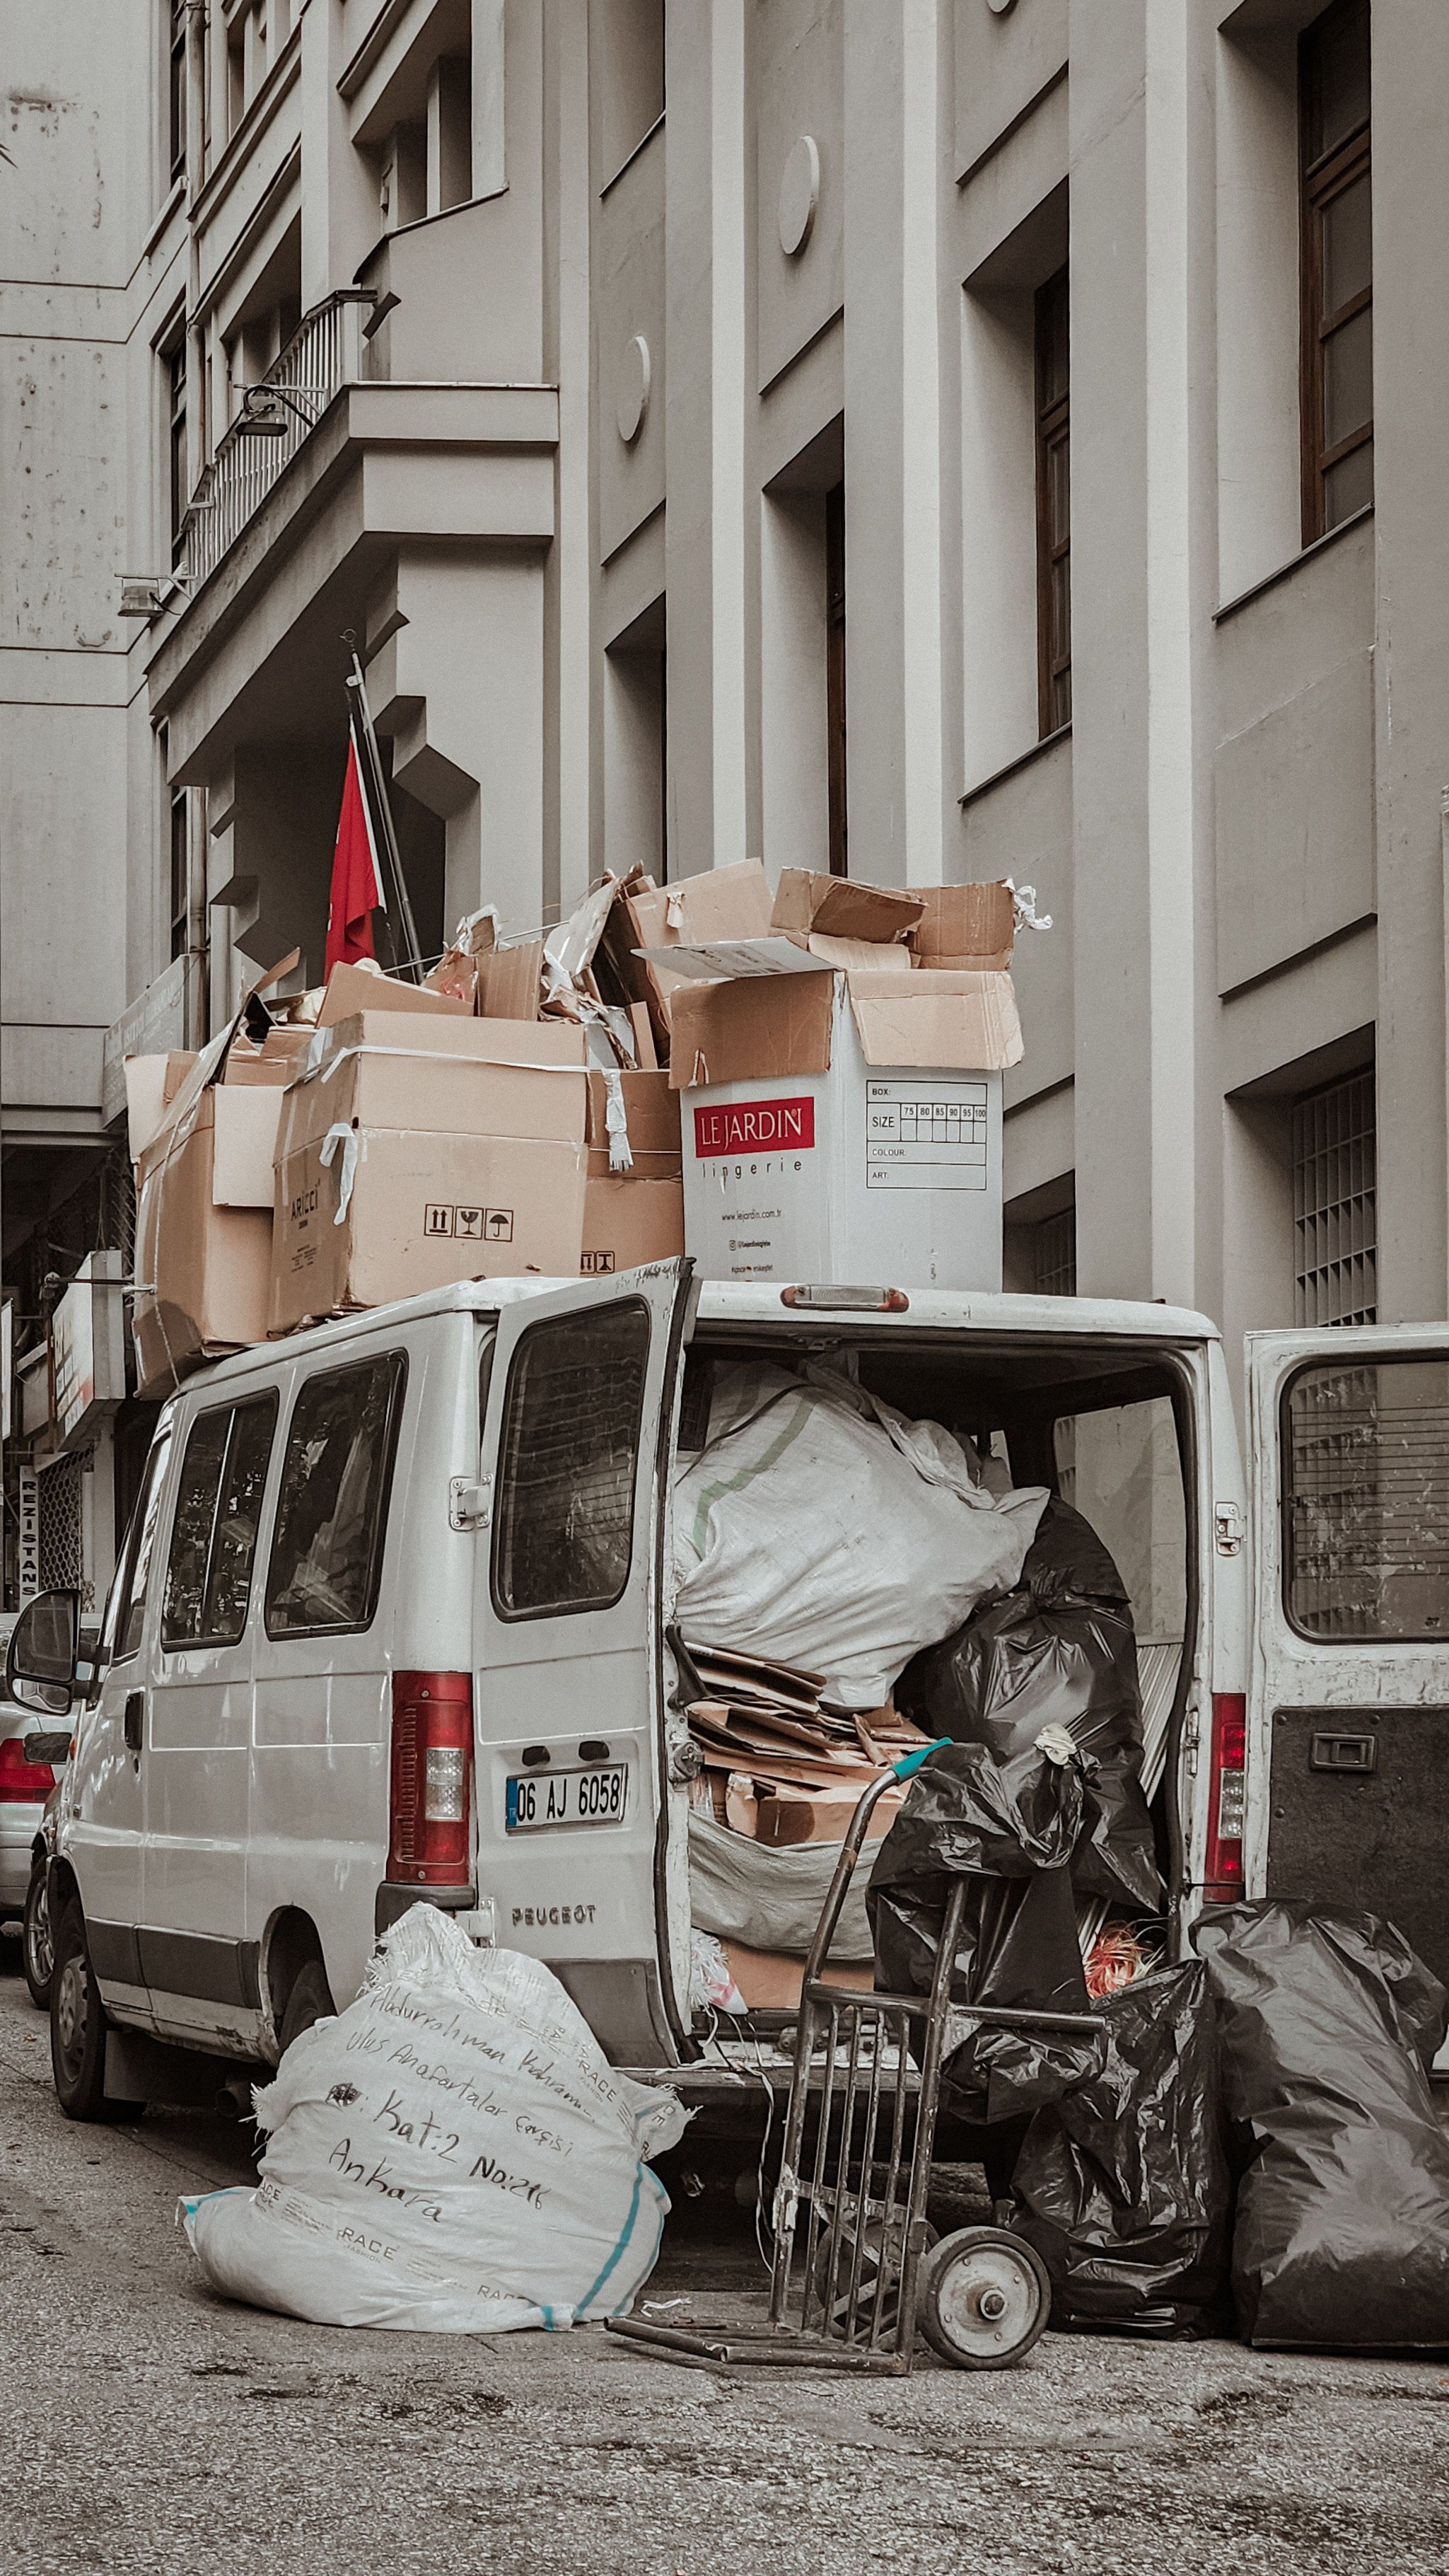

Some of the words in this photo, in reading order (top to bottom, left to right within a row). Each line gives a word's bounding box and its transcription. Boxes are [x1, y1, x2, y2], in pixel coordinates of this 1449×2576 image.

[872, 1116, 895, 1128] SIZE
[904, 1107, 914, 1115] 75
[936, 1108, 945, 1116] 85
[962, 1108, 972, 1117] 95
[975, 1109, 986, 1118] 100
[702, 1156, 803, 1179] lingerie
[517, 1782, 536, 1822] 06
[547, 1778, 567, 1819] AJ
[578, 1773, 620, 1816] 6058
[512, 1904, 596, 1926] PEUGEOT
[578, 2059, 617, 2103] RACE
[342, 2227, 398, 2262] RACE
